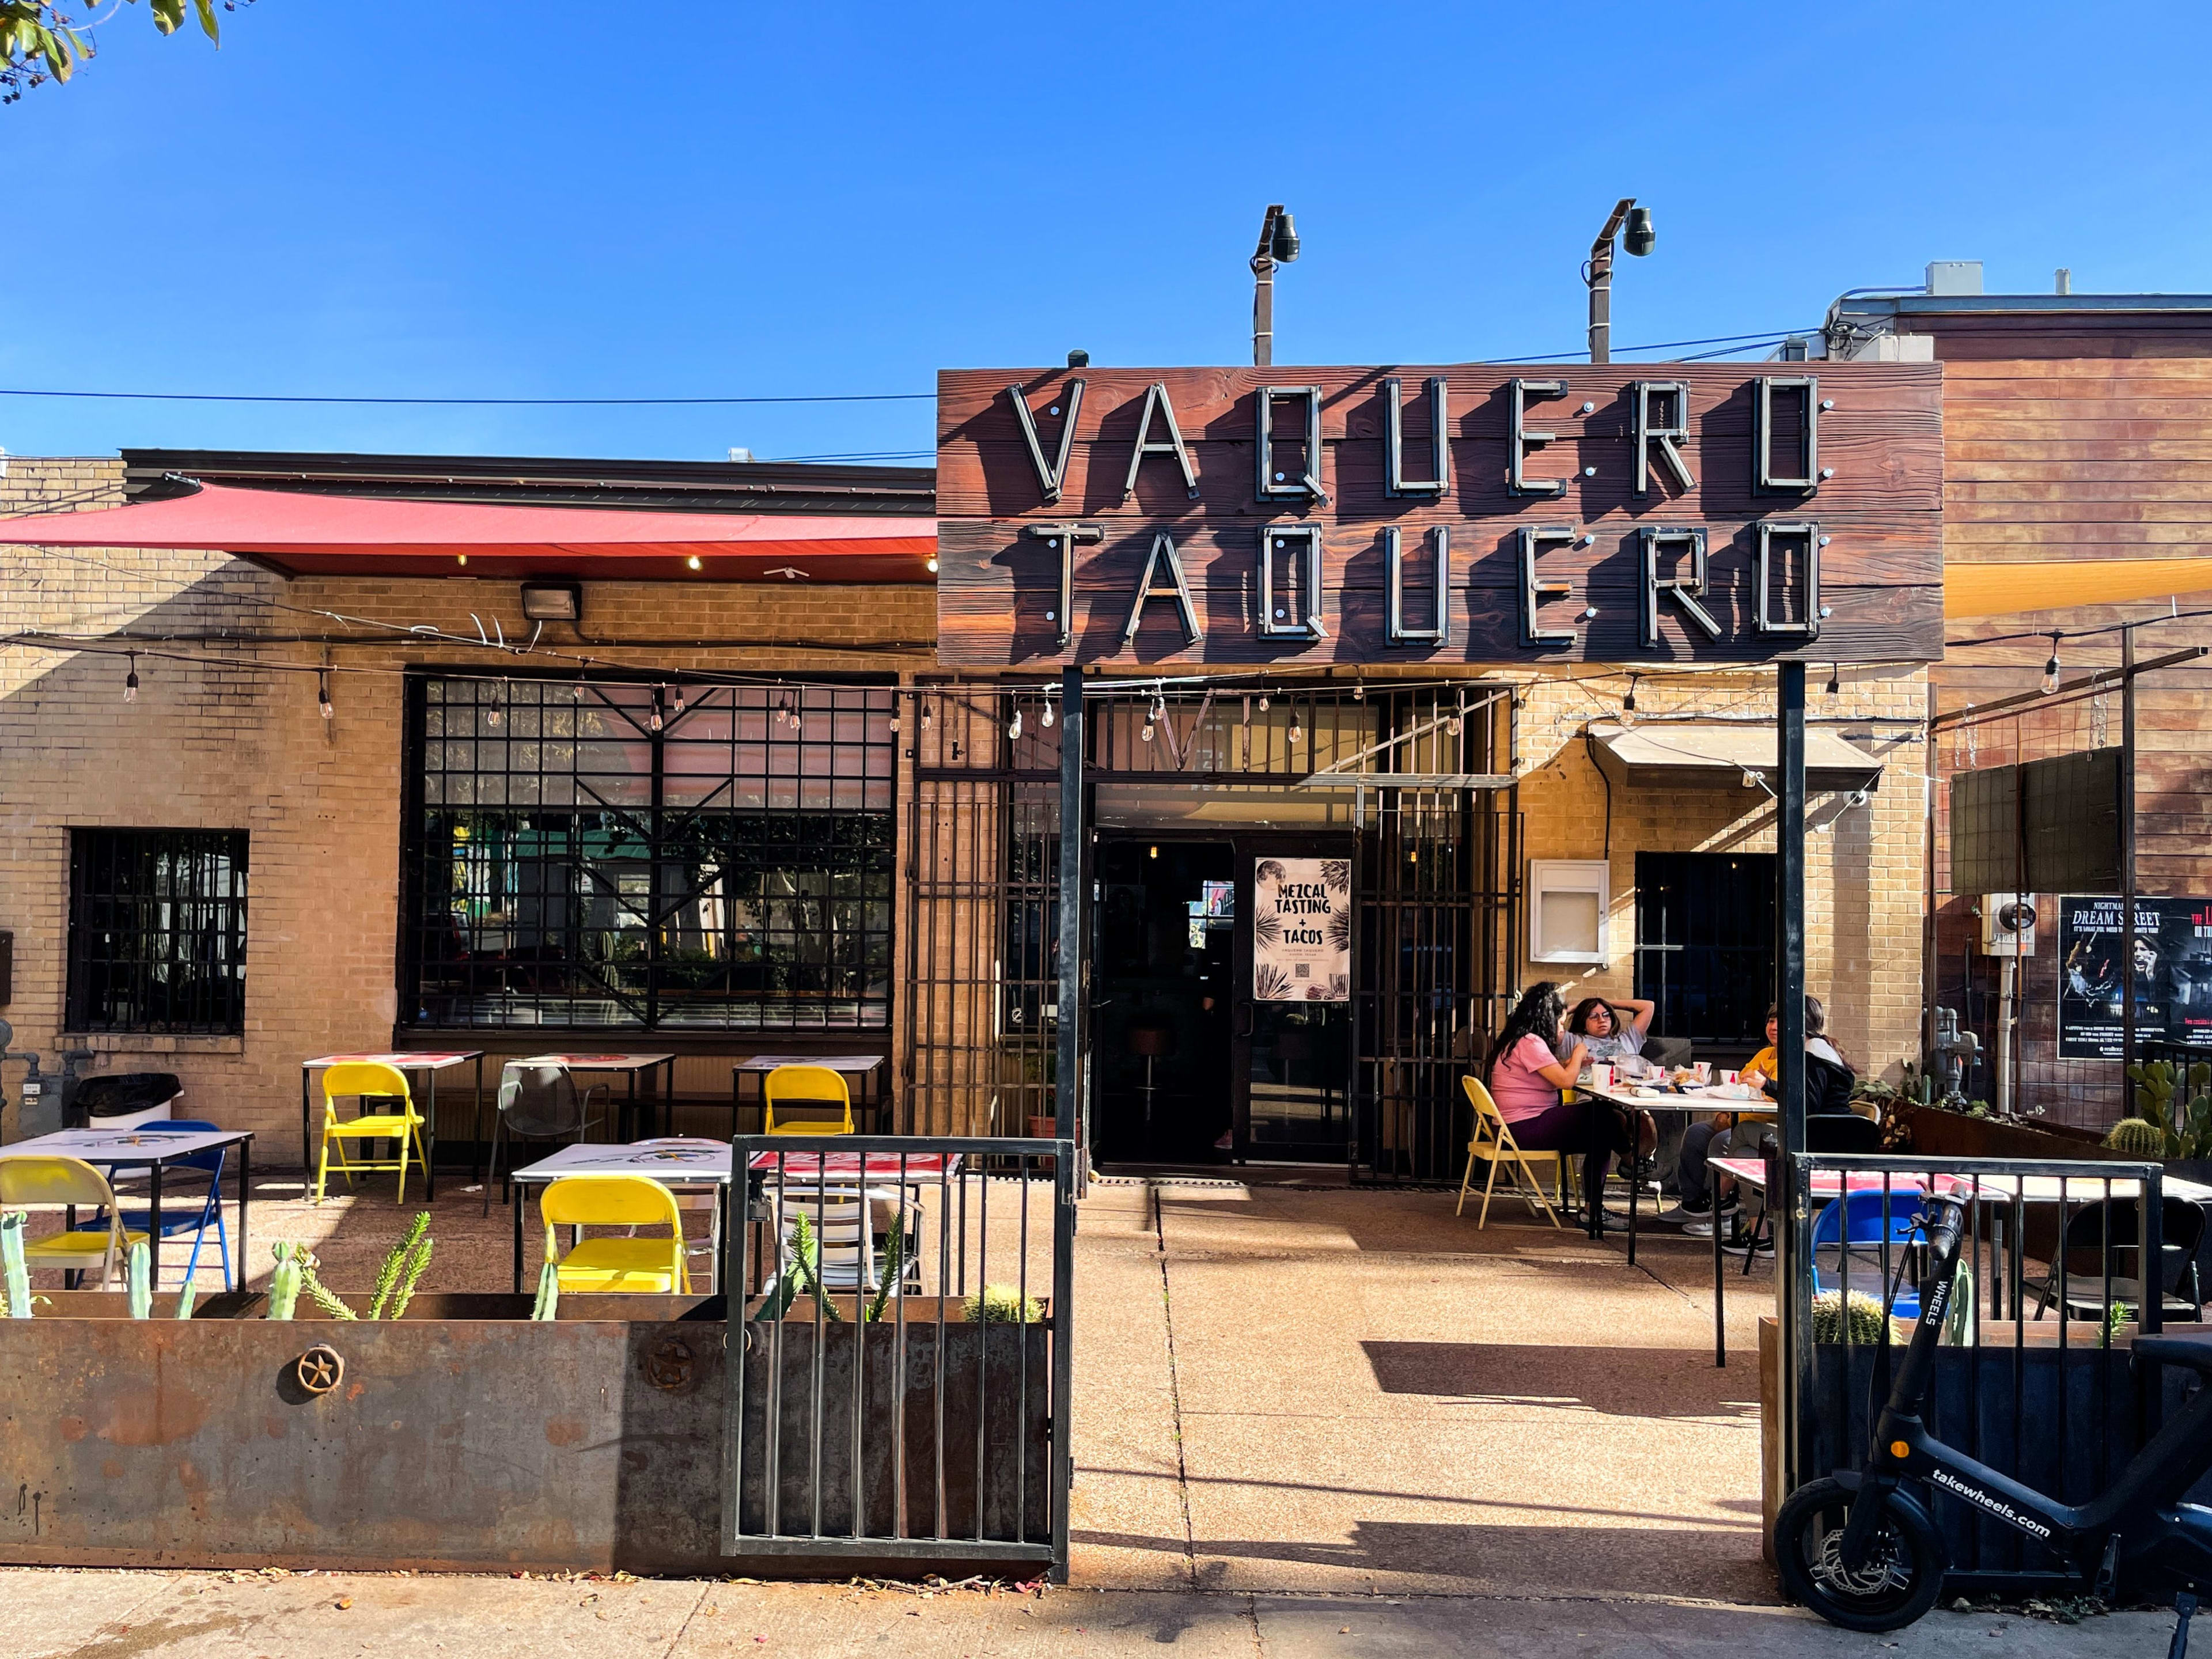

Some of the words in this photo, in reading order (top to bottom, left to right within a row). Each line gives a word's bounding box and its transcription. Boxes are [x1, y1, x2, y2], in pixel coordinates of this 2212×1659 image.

[1006, 375, 1819, 507] VAQUERO
[1028, 521, 1820, 647] TAQUERO
[1277, 884, 1328, 899] MEZCAL
[1275, 899, 1331, 914] TASTING
[2093, 902, 2124, 911] NIGHTMA
[2072, 910, 2114, 925] DREAM
[2118, 911, 2160, 926] SREET
[1283, 929, 1323, 945] TACOS
[1925, 1280, 1948, 1326] WHEELS
[1932, 1468, 2051, 1539] takewheels.com
